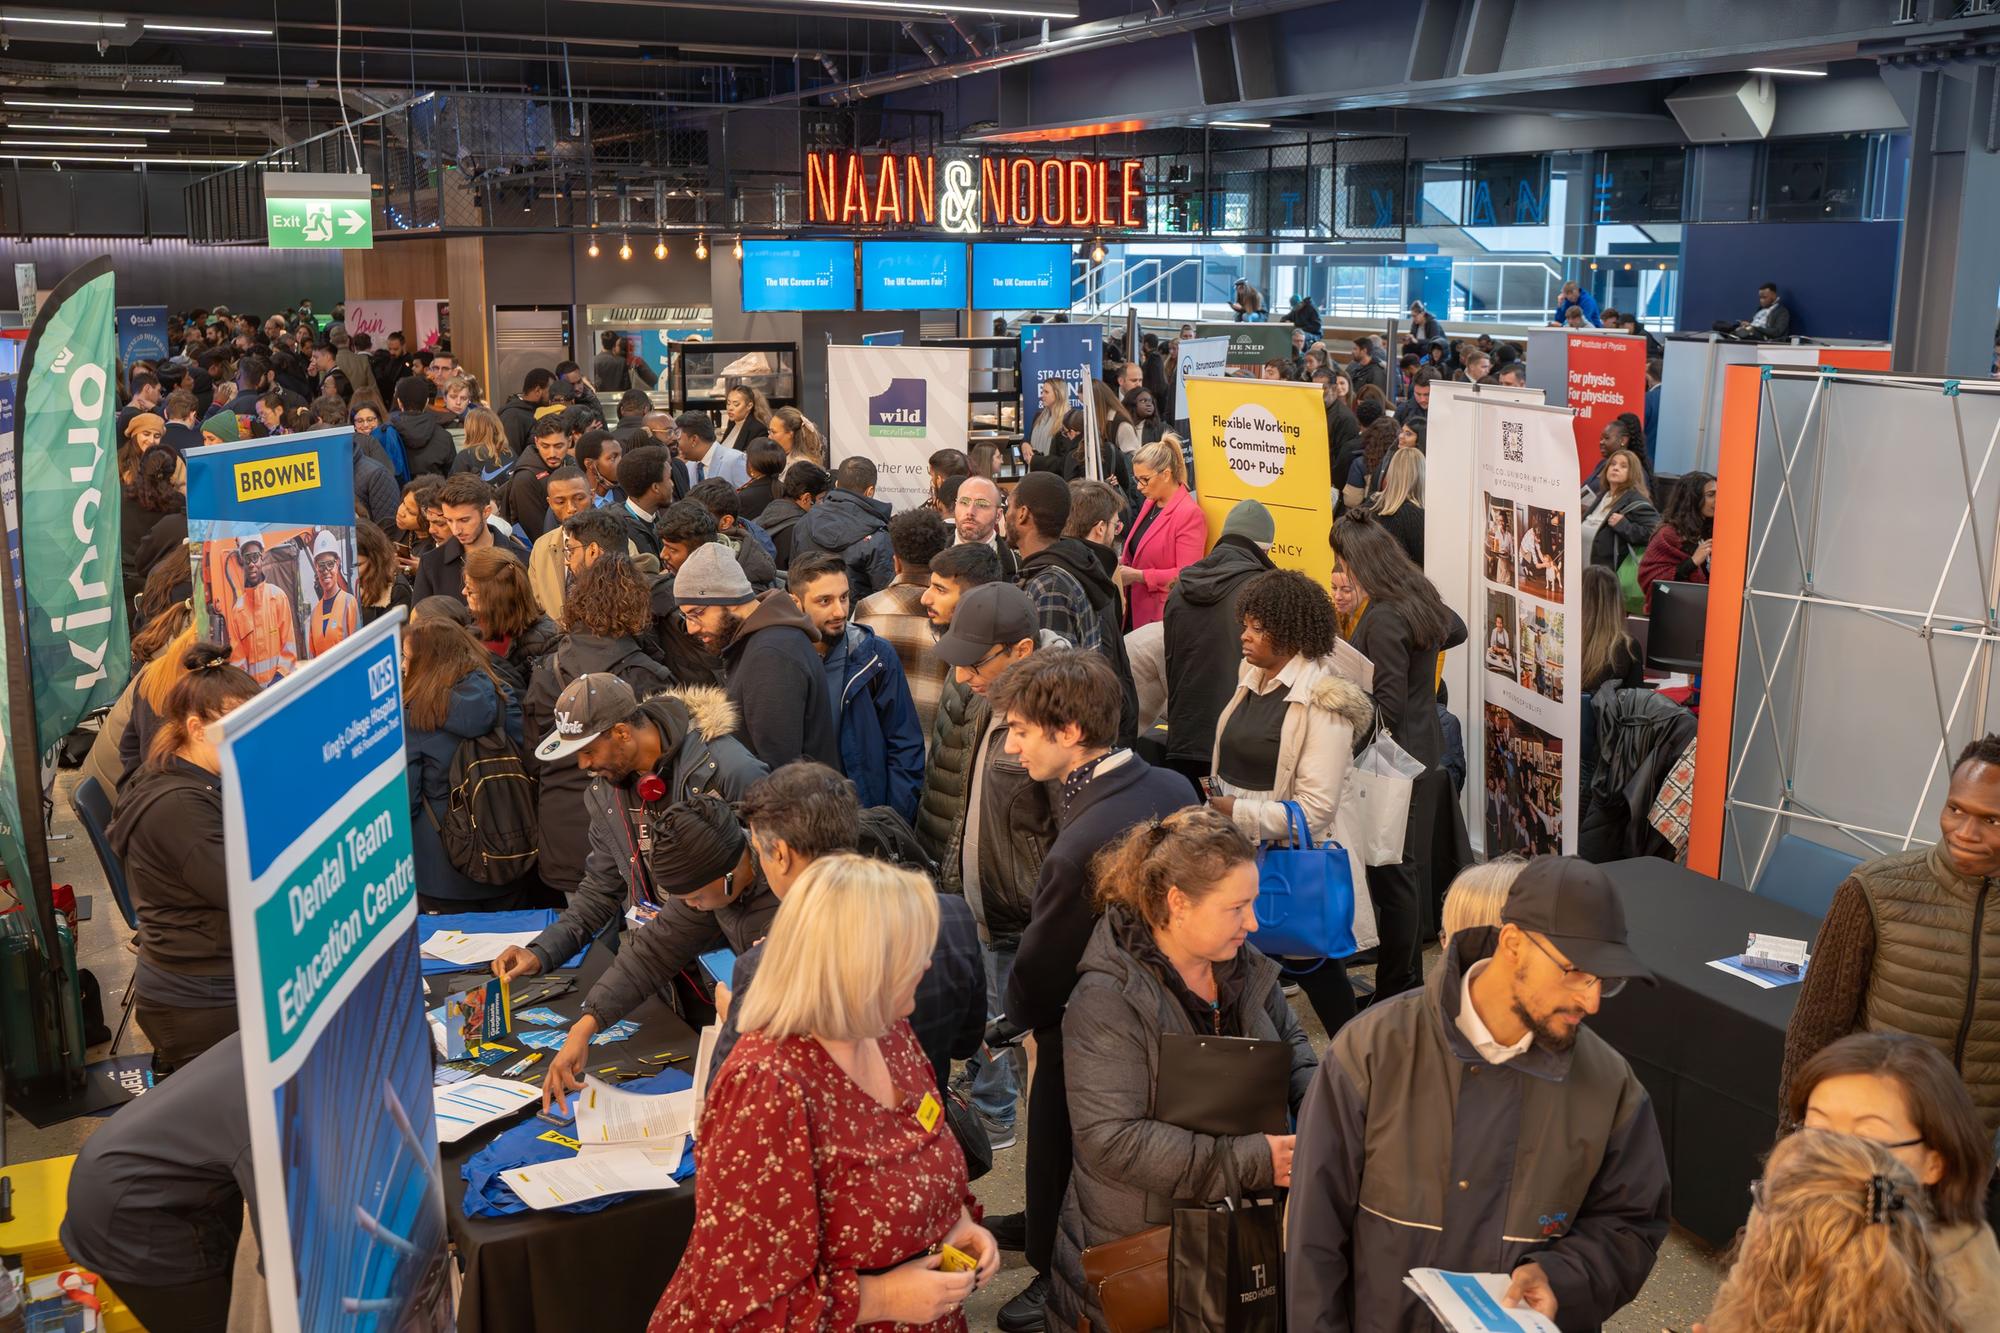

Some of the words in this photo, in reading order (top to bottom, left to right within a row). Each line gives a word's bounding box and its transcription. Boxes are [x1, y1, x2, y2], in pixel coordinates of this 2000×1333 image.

[807, 152, 934, 223] NAAN
[940, 159, 981, 233] &
[981, 156, 1143, 226] NOODLE
[272, 215, 301, 228] Exit
[766, 277, 778, 287] The
[779, 277, 789, 287] UK
[790, 277, 815, 287] Careers
[816, 277, 829, 287] Fair
[884, 277, 895, 286] The
[896, 277, 906, 286] UK
[906, 277, 930, 286] Careers
[931, 277, 943, 286] Fair
[993, 278, 1004, 287] The
[1004, 278, 1014, 287] UK
[1014, 278, 1037, 287] Careers
[1037, 278, 1049, 287] Fair
[351, 307, 386, 336] Join
[1570, 339, 1581, 347] IOP
[1608, 343, 1627, 352] Physics
[1037, 369, 1083, 380] STRATEGI
[1568, 370, 1581, 383] For
[1582, 371, 1616, 388] physics
[1568, 387, 1581, 400] For
[1581, 389, 1624, 406] physicists
[880, 408, 921, 423] wild
[1580, 405, 1592, 418] all
[1212, 415, 1251, 430] Flexible
[1253, 418, 1300, 437] Working
[1212, 435, 1227, 448] No
[1229, 437, 1296, 455] Commitment
[877, 462, 902, 474] ther
[905, 465, 922, 475] we
[1229, 458, 1256, 471] 200+
[1259, 461, 1284, 476] Pubs
[240, 461, 316, 493] BROWNE
[1271, 543, 1303, 557] ENCY
[370, 657, 393, 697] NHS
[322, 733, 346, 763] King's
[345, 716, 371, 745] College
[370, 691, 398, 726] Hospital
[288, 842, 346, 937] Dental
[345, 809, 393, 872] Team
[277, 909, 363, 1036] Education
[363, 853, 414, 926] Centre
[1240, 1291, 1258, 1303] TREO
